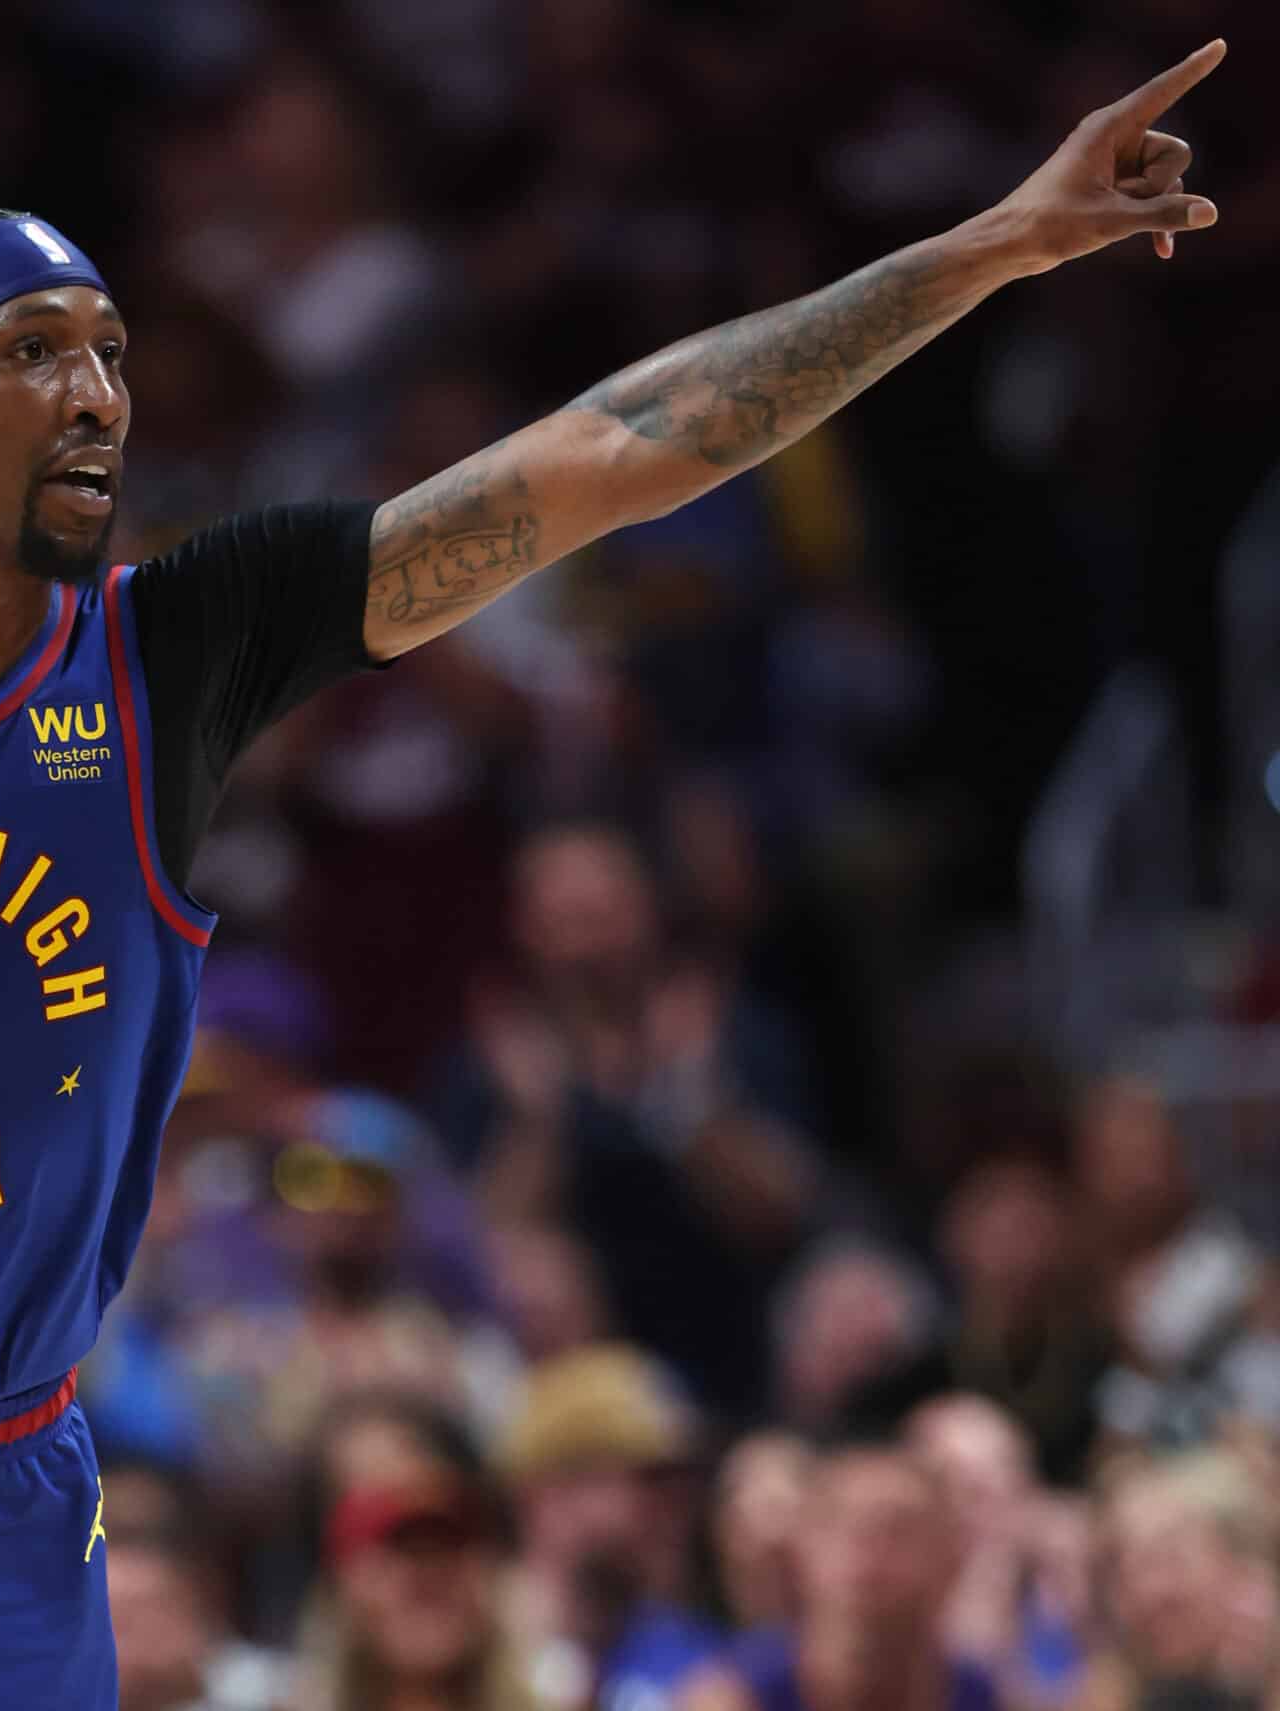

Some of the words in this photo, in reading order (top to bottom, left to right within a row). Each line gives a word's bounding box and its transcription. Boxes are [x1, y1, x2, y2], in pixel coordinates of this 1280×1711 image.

[28, 703, 107, 744] WU
[32, 746, 112, 765] Western
[47, 762, 102, 782] Union
